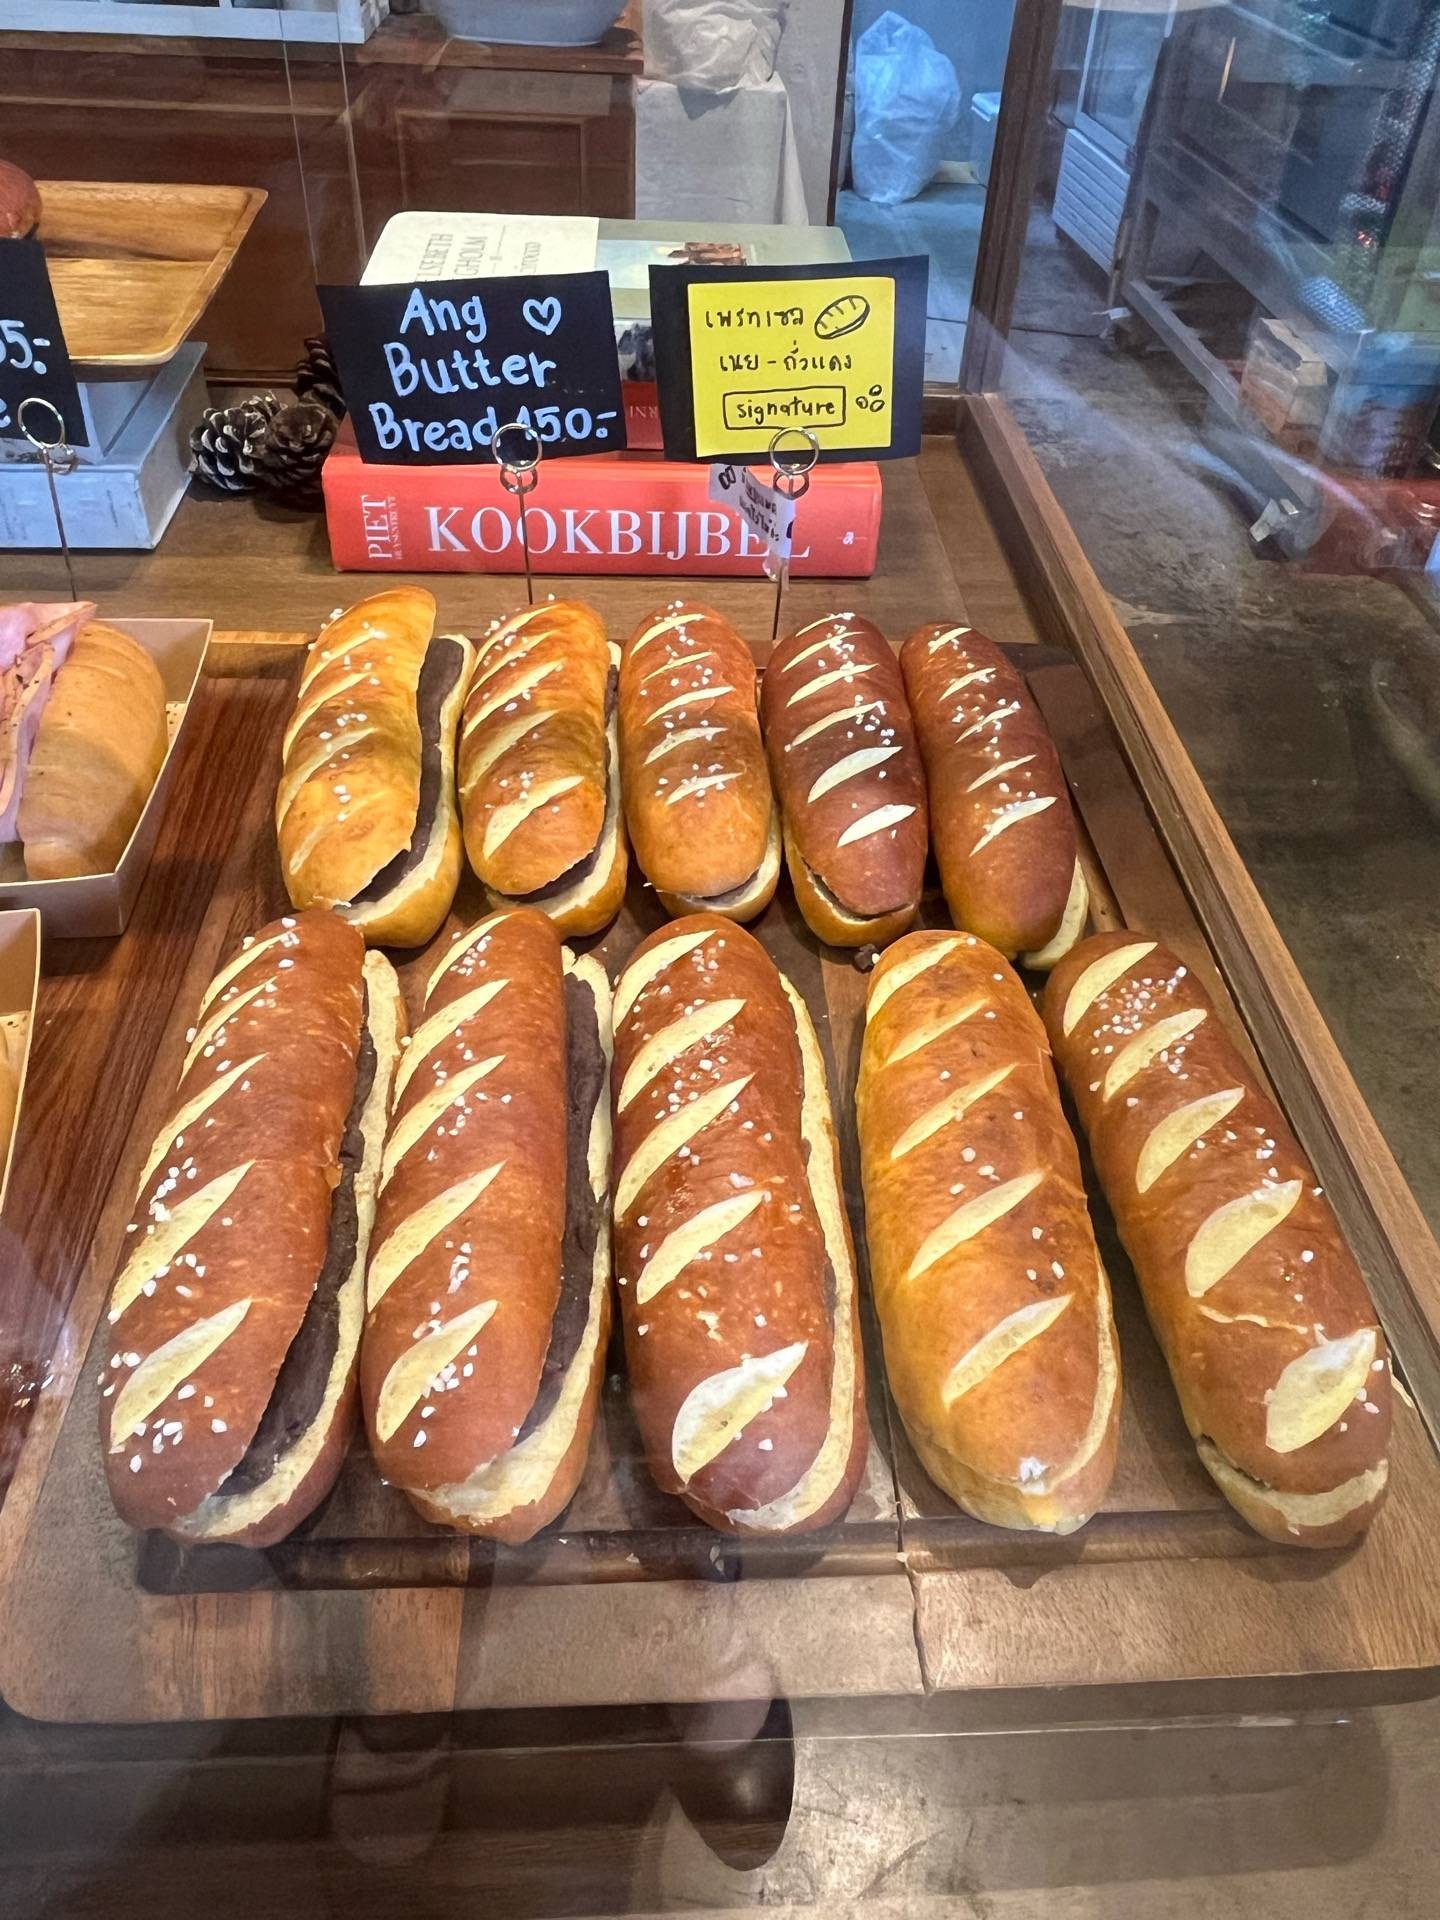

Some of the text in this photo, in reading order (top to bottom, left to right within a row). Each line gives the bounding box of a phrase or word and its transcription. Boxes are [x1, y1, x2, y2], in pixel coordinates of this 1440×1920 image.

[415, 233, 454, 282] LSEBETH
[452, 236, 489, 280] GHOLM
[400, 287, 487, 344] Ang
[383, 341, 557, 397] Butter
[368, 401, 501, 452] Bread
[736, 396, 836, 425] signature
[360, 494, 393, 559] PIET
[424, 506, 810, 561] KOOKBIJBE
